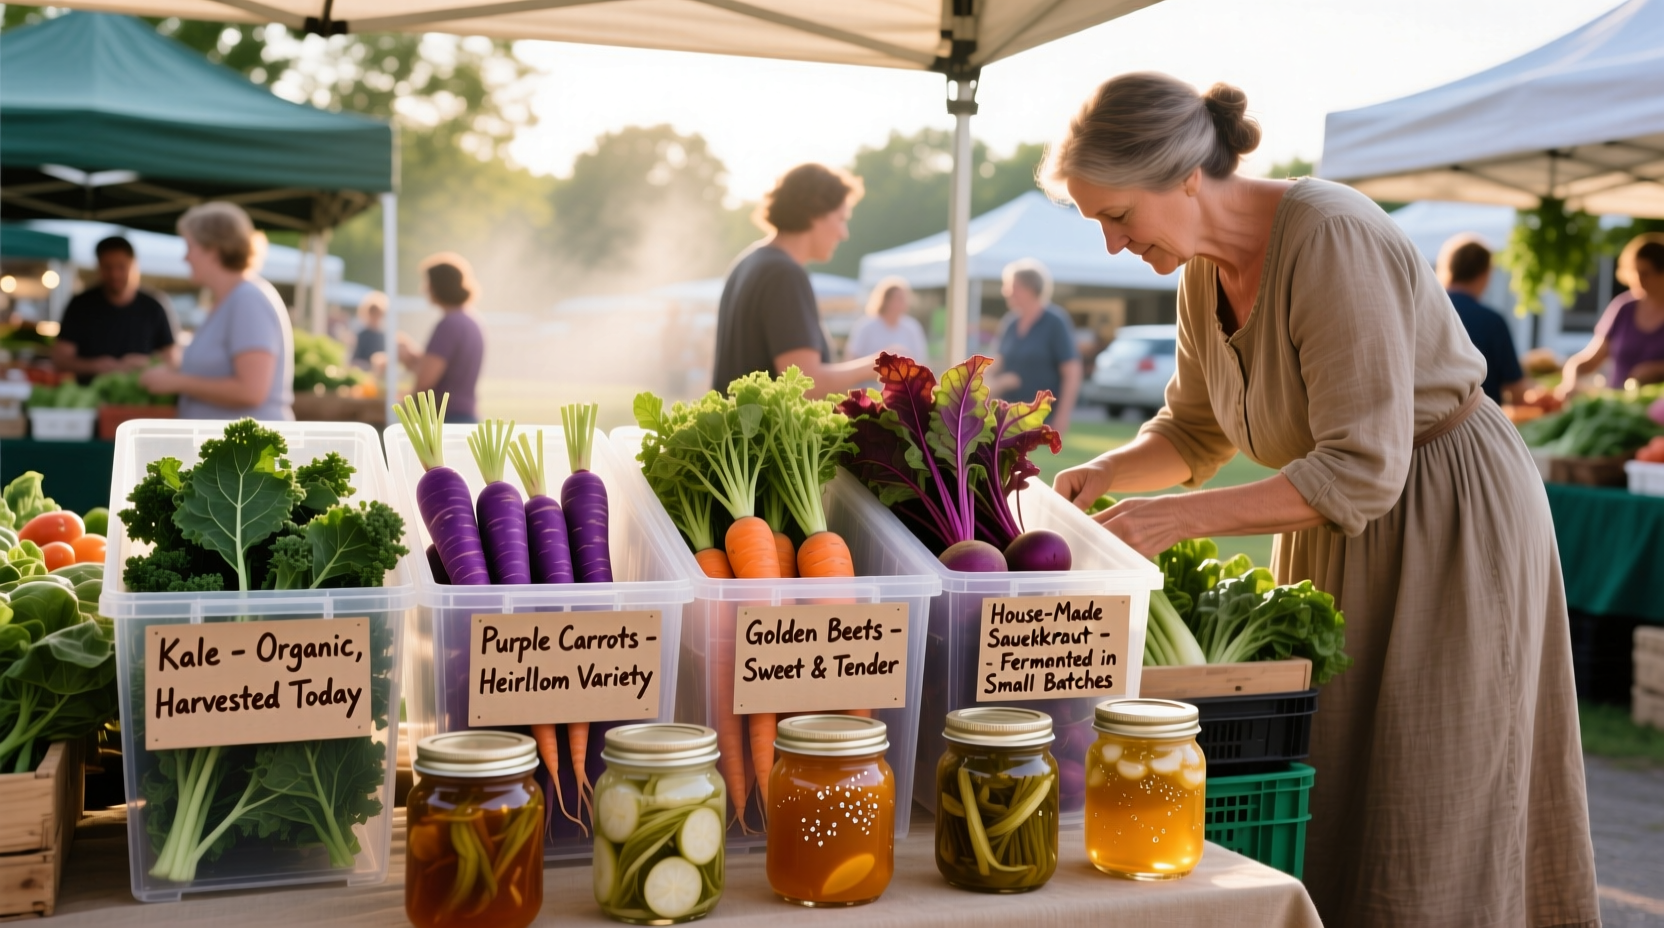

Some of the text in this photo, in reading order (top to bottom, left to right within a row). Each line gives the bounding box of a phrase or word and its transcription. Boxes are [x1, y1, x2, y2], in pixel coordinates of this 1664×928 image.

[991, 600, 1103, 625] House-Made
[482, 625, 551, 664] Purple
[559, 625, 639, 652] Carrots
[745, 618, 818, 646] Golden
[827, 618, 883, 643] Beets
[159, 637, 221, 671] Kale
[257, 632, 363, 672] Organic,
[743, 652, 900, 683] Sweet & Tender
[1100, 650, 1117, 666] in
[480, 663, 654, 700] Heirllom Variety
[984, 670, 1113, 695] Small Batches
[156, 677, 363, 720] Harvested Today
